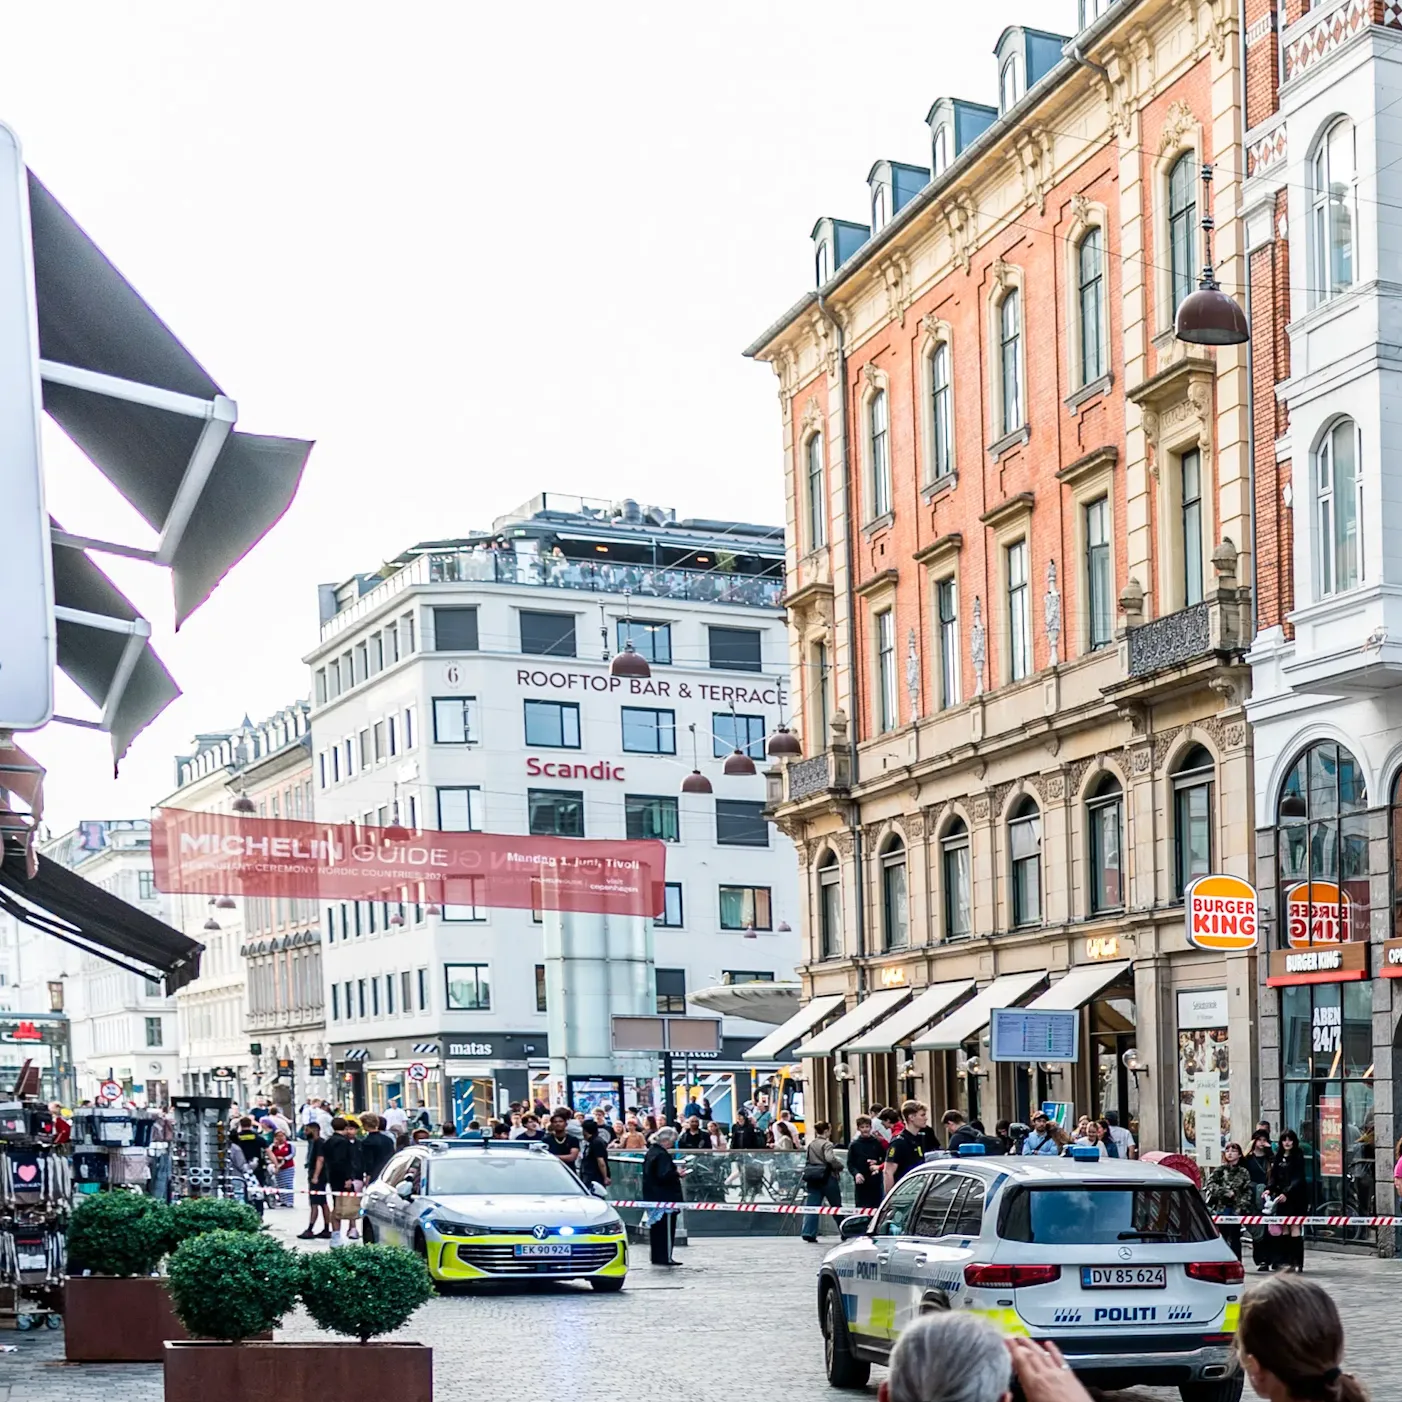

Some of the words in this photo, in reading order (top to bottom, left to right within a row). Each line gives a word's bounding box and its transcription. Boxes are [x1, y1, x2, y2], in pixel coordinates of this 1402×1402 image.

[517, 669, 621, 692] ROOFTOP
[630, 680, 671, 698] BAR
[678, 683, 692, 699] &
[698, 684, 788, 706] TERRACE
[526, 757, 626, 782] Scandic
[180, 833, 344, 860] MICHELIN
[351, 844, 449, 867] GUIDE
[506, 852, 557, 868] Mandag
[605, 858, 640, 871] Tivoli
[255, 864, 315, 874] CEREMONY
[318, 867, 358, 877] NORDIC
[362, 869, 422, 879] COUNTRIES
[1193, 899, 1255, 915] BURGER
[1193, 913, 1255, 936] KING
[1286, 952, 1318, 973] BURGER
[1318, 949, 1340, 970] KING
[1312, 1025, 1341, 1052] 24/7
[449, 1042, 493, 1057] matas
[522, 1245, 535, 1254] EK
[537, 1245, 550, 1254] 90
[553, 1245, 570, 1254] 924
[855, 1261, 879, 1281] POLITI
[1092, 1270, 1114, 1284] DV
[1116, 1270, 1134, 1283] 85
[1136, 1269, 1164, 1283] 624
[1094, 1306, 1156, 1322] POLITI
